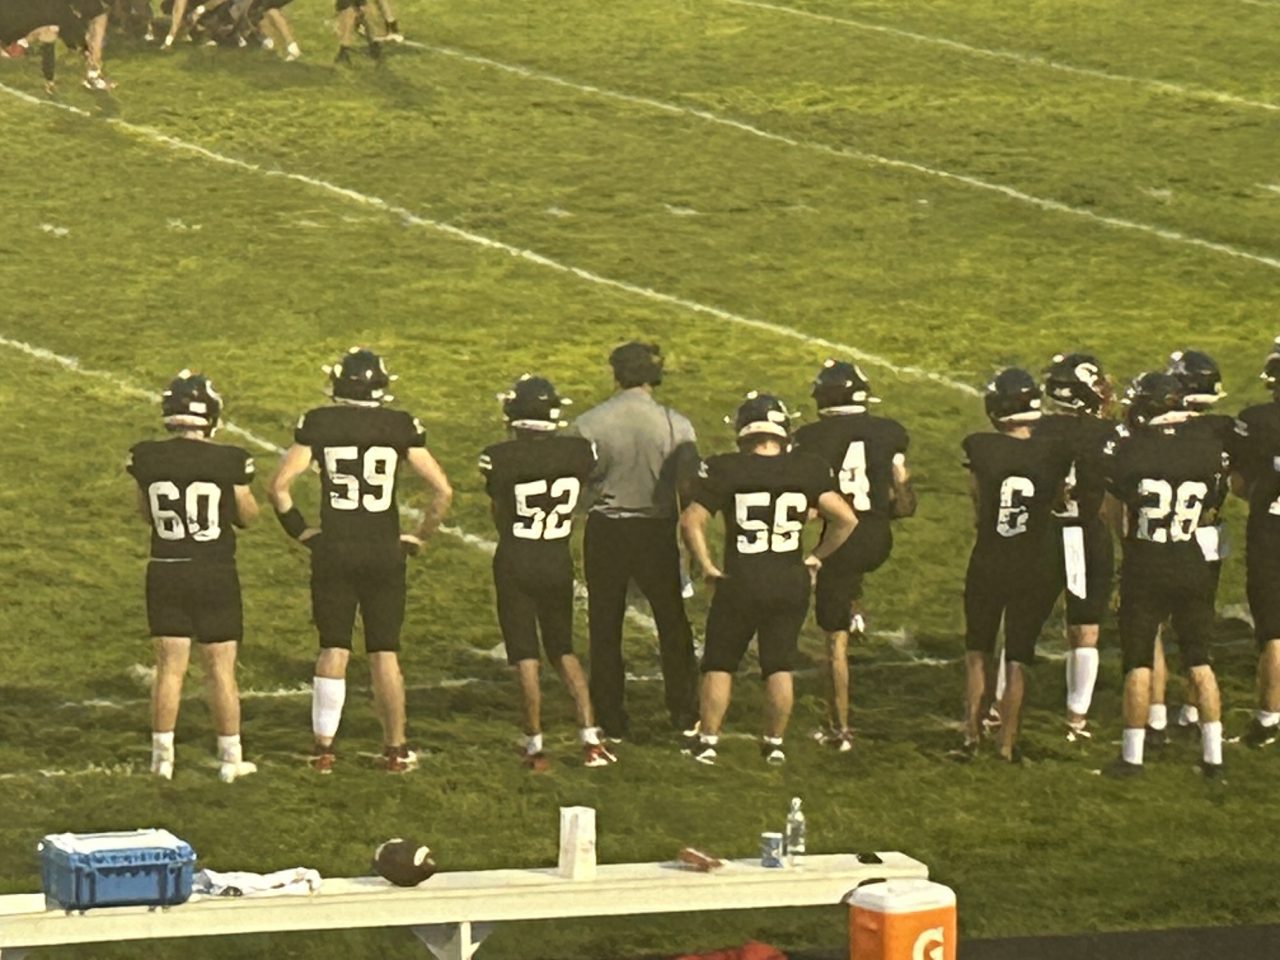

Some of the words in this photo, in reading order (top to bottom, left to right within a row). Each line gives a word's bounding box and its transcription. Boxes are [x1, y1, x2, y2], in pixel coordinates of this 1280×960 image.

[323, 446, 398, 512] 59
[838, 440, 871, 511] 4
[996, 476, 1035, 537] 6
[148, 481, 221, 542] 60
[513, 477, 580, 540] 52
[734, 491, 807, 553] 56
[912, 926, 945, 960] G
